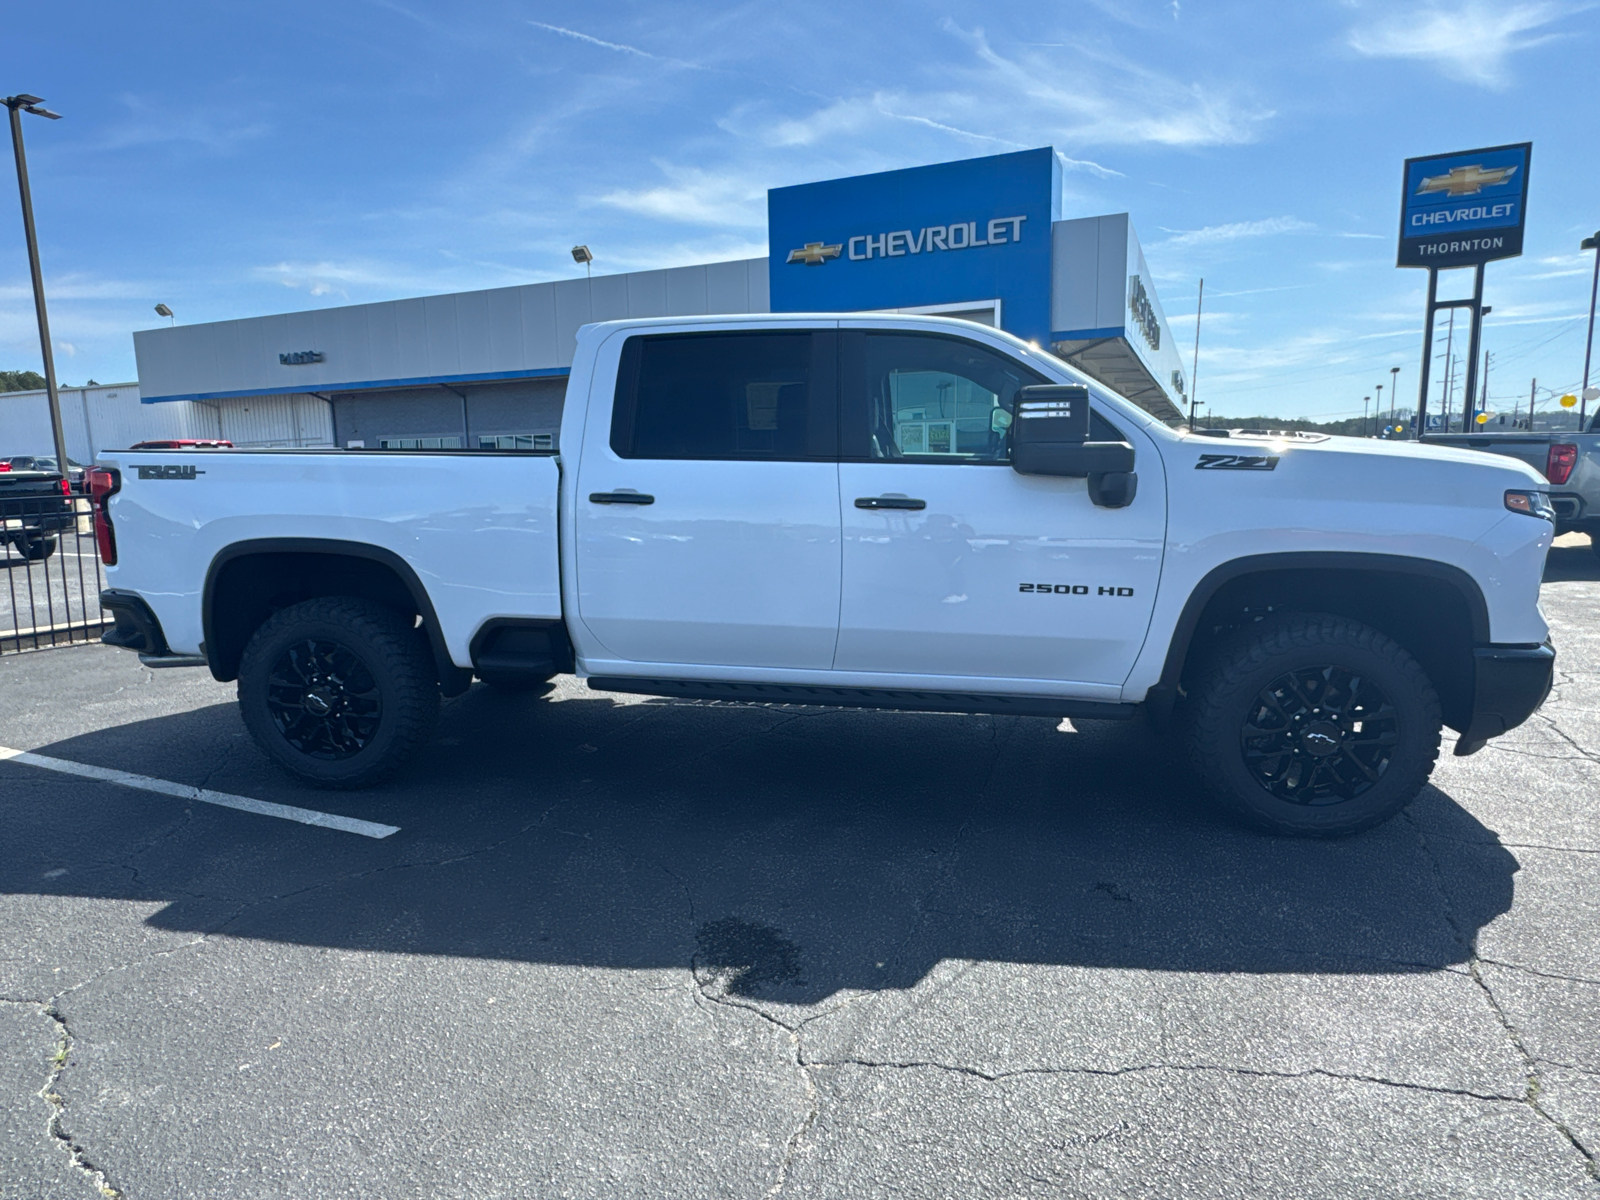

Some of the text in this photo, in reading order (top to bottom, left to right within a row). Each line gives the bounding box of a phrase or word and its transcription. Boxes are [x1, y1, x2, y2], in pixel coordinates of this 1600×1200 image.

[1411, 203, 1514, 226] CHEVROLET
[848, 215, 1027, 261] CHEVROLET
[1418, 237, 1503, 255] THORNTON
[1019, 583, 1134, 597] 2500 HD
